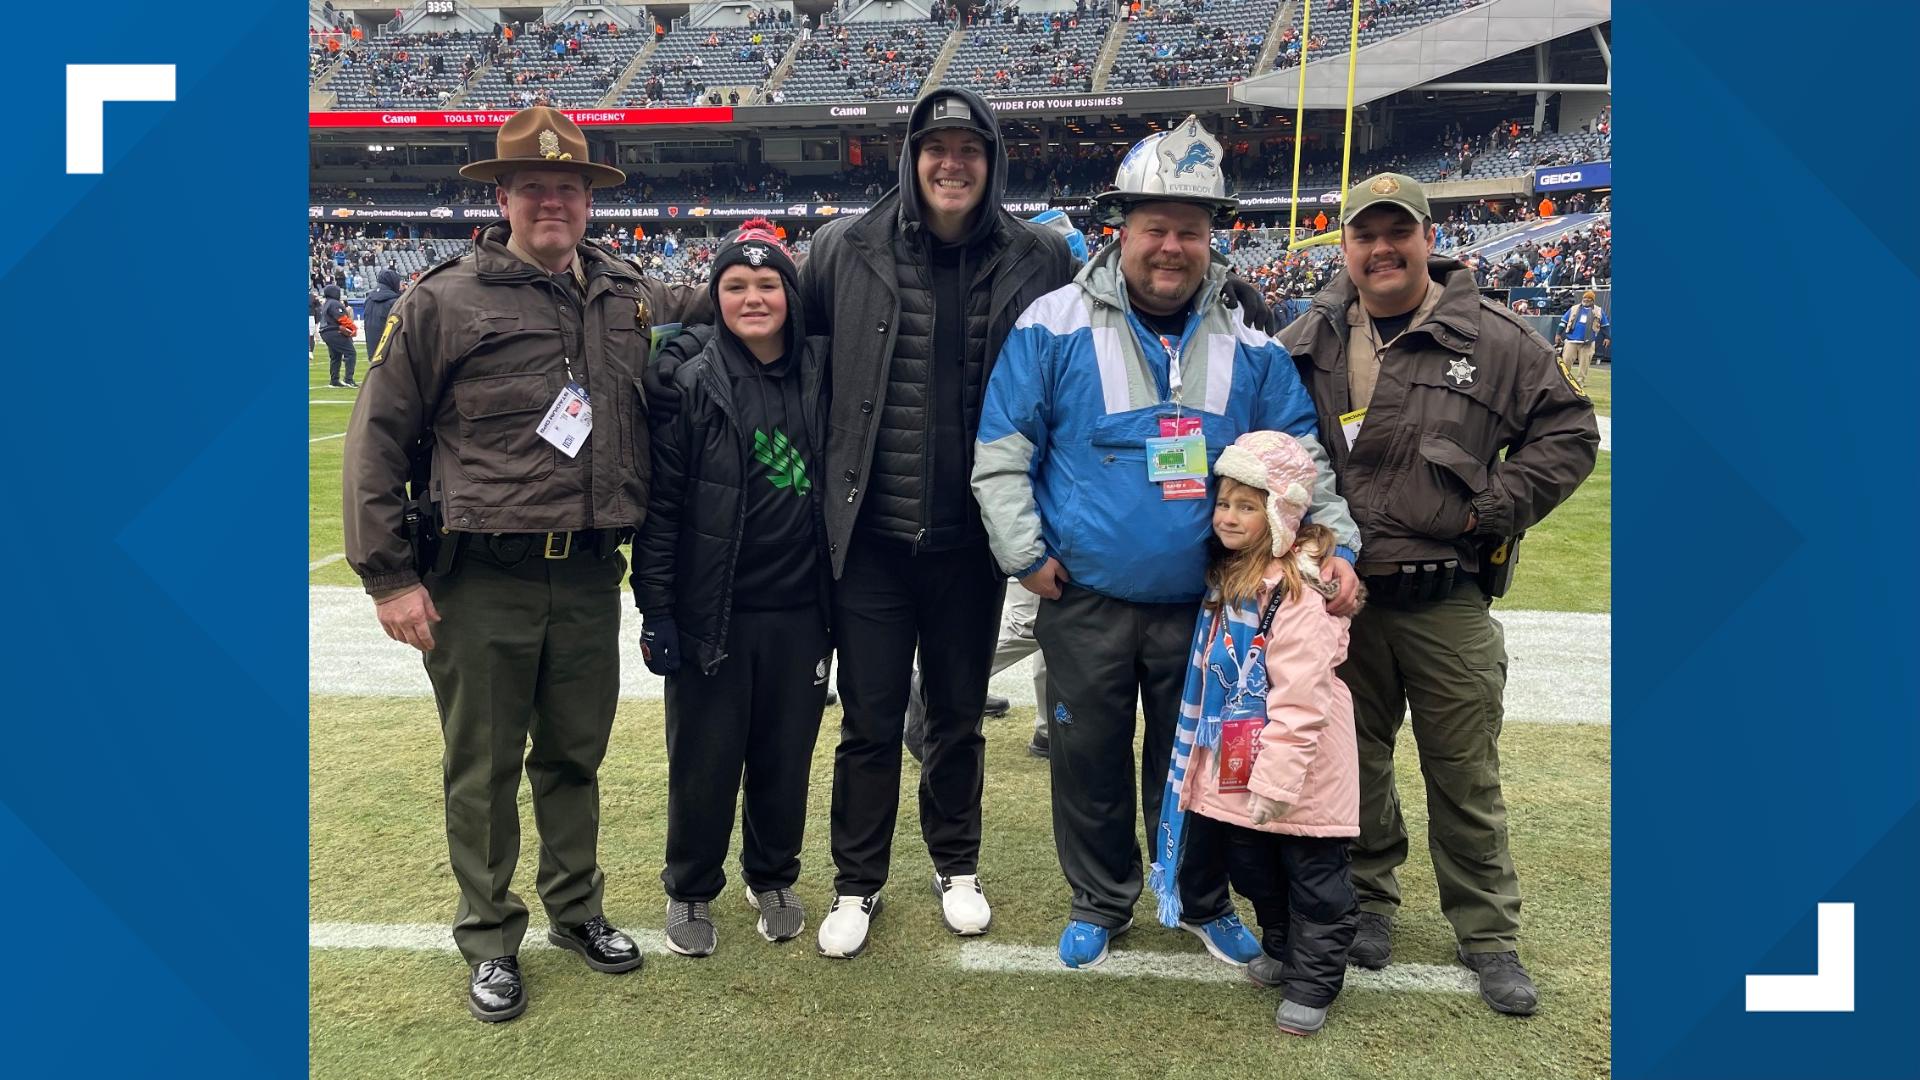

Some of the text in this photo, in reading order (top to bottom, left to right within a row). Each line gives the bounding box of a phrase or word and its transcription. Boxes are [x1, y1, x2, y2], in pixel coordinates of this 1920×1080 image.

[830, 97, 1124, 116] Canon AN OVIDER FOR YOUR BUSINESS
[382, 114, 417, 124] Canon
[444, 114, 472, 123] TOOLS
[474, 114, 486, 123] TO
[488, 114, 513, 123] TACK
[576, 112, 626, 122] EFFICIENCY
[1540, 171, 1582, 186] GEICO
[356, 208, 499, 218] ChevyDrivesChicago.com OFFICIAL
[595, 207, 629, 217] CHICAGO
[632, 207, 660, 217] BEARS
[712, 207, 785, 217] ChevyDrivesChicago.com
